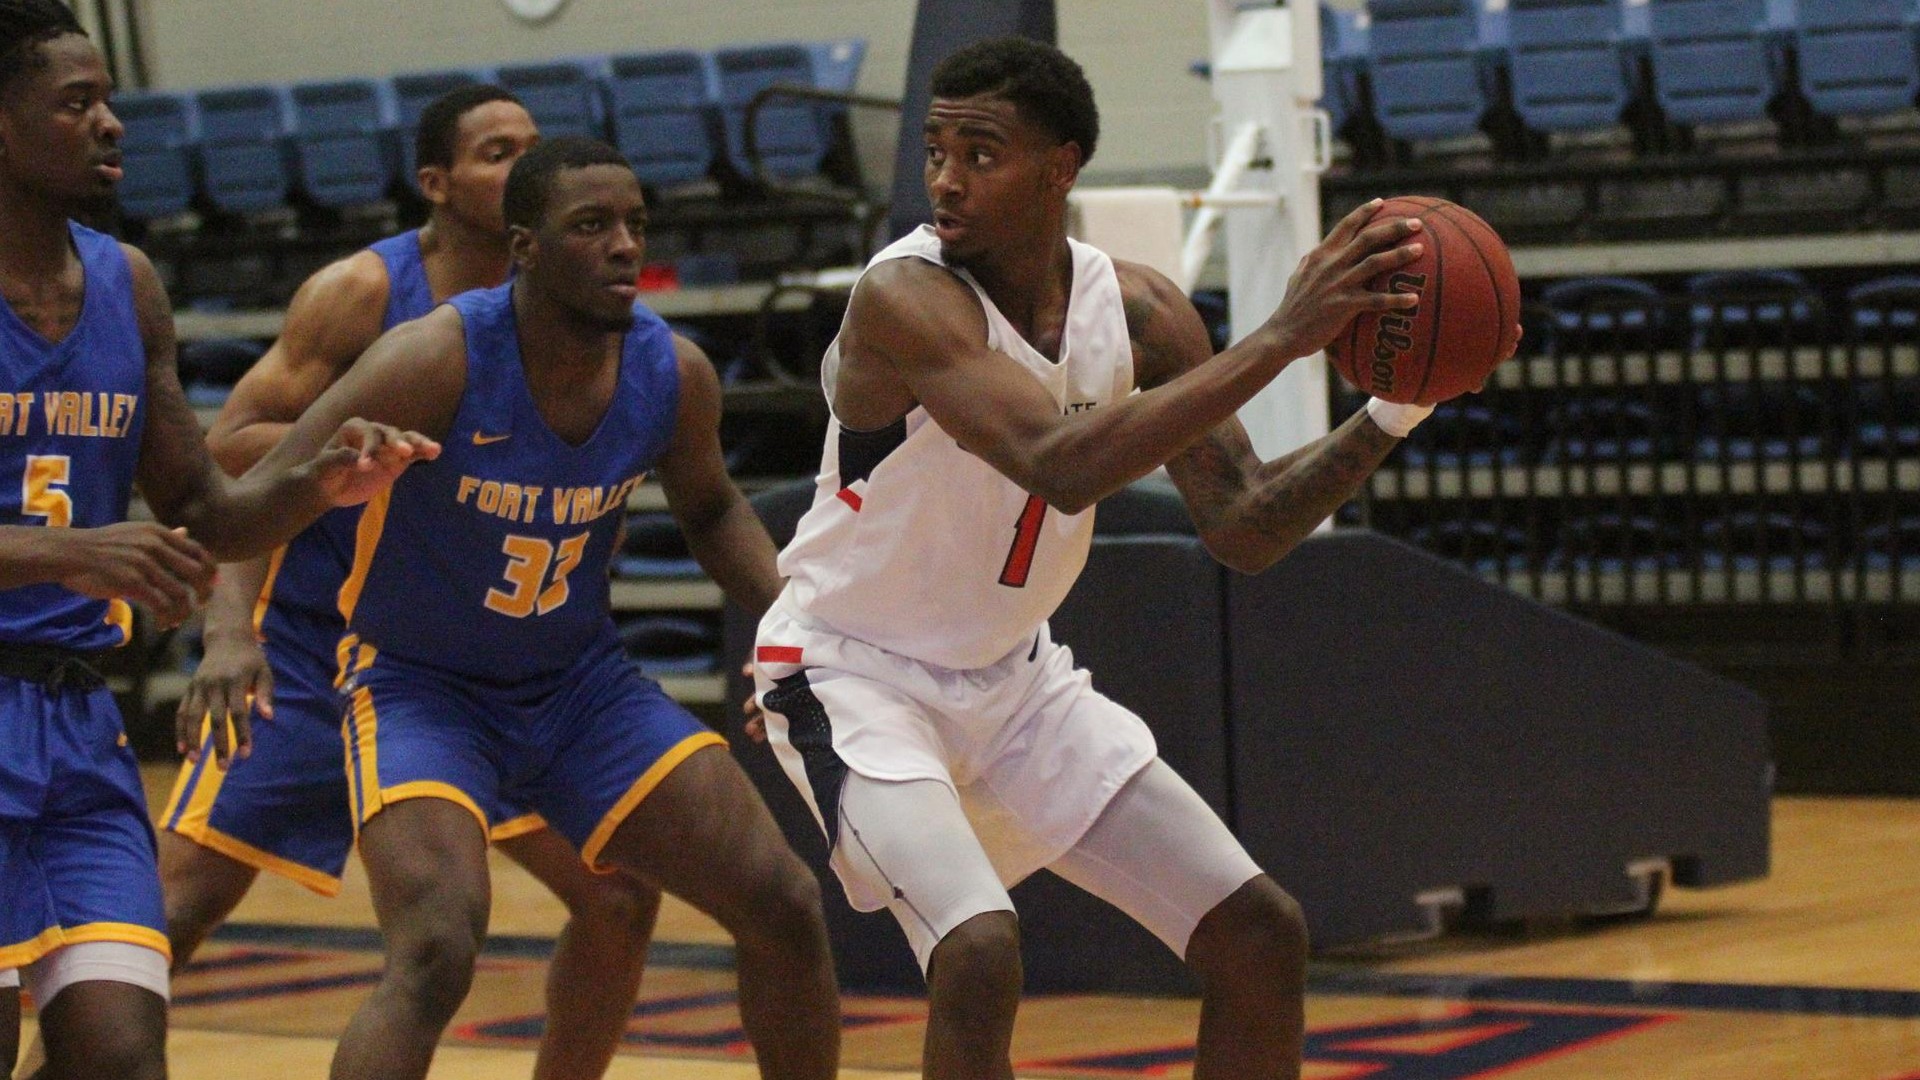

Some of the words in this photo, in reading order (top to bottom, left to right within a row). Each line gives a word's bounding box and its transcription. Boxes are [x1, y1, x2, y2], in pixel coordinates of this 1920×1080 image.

[44, 391, 138, 438] VALLEY
[22, 454, 72, 527] 5
[456, 475, 543, 523] FORT
[483, 531, 590, 619] 33
[998, 494, 1048, 588] 1
